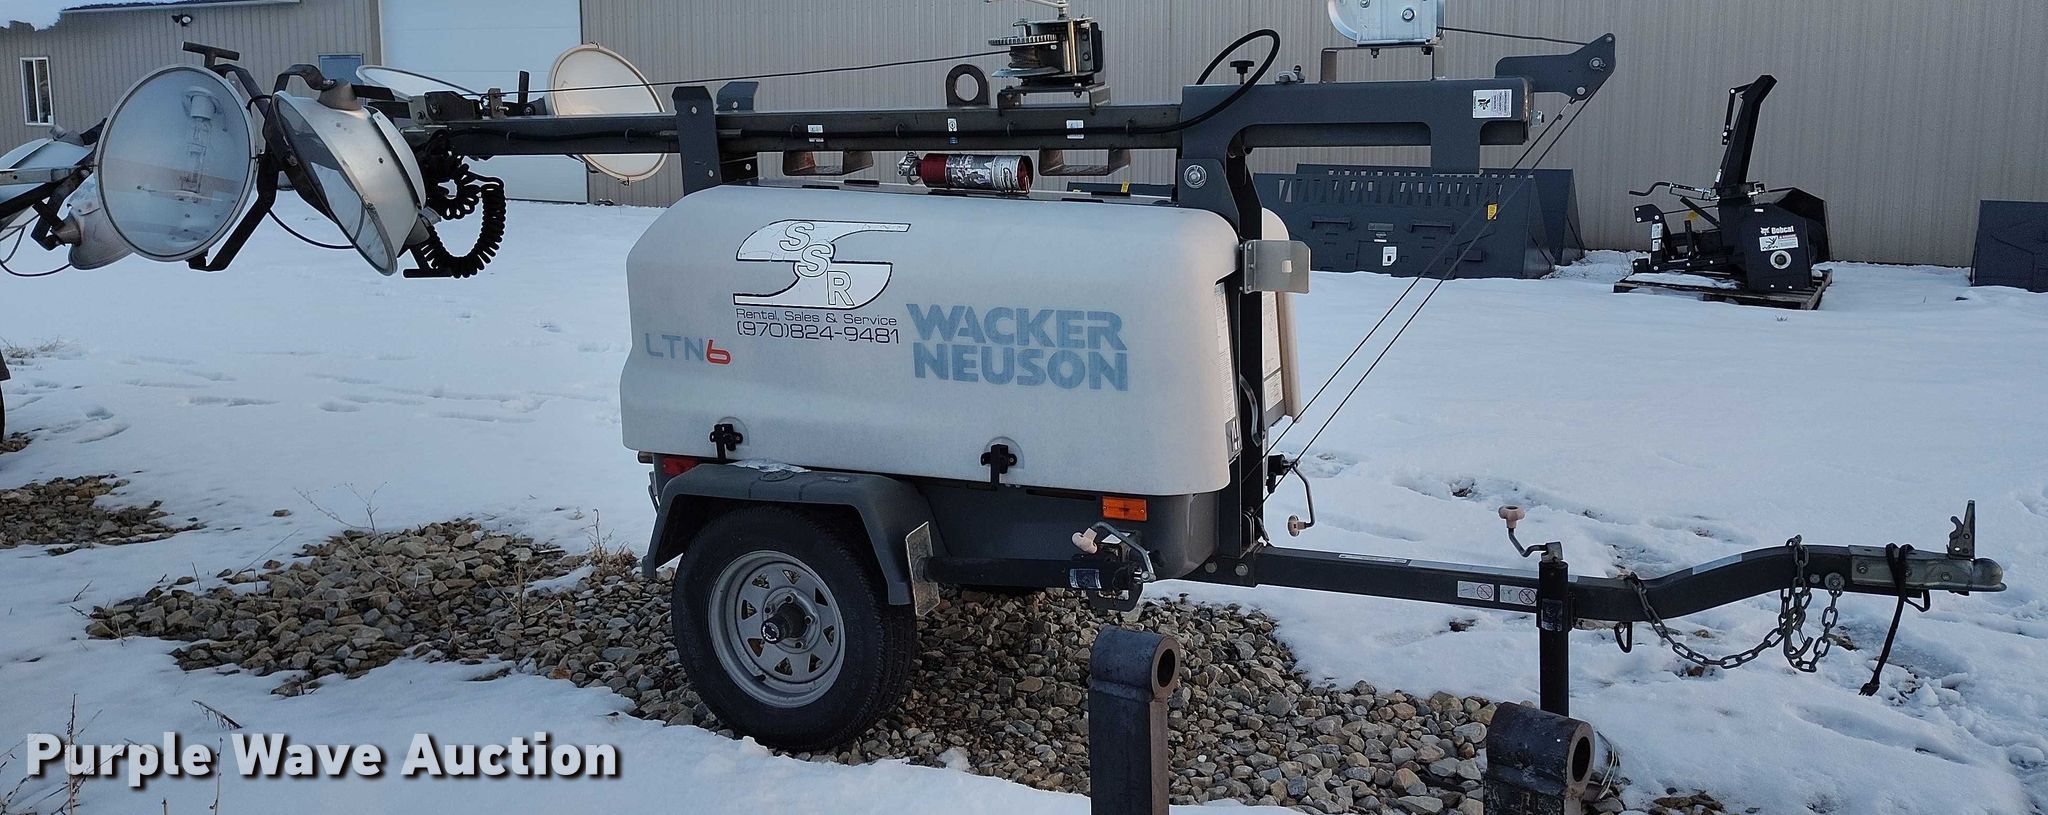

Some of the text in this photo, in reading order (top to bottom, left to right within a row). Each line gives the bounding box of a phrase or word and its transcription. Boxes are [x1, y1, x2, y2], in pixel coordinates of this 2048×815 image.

[1771, 225, 1794, 235] Bobcat
[778, 221, 855, 306] SSR
[736, 308, 897, 326] Rental, Sales & Service
[736, 320, 900, 344] (970)824-9481
[905, 303, 1128, 350] WACKER
[912, 342, 1128, 391] NEUSON
